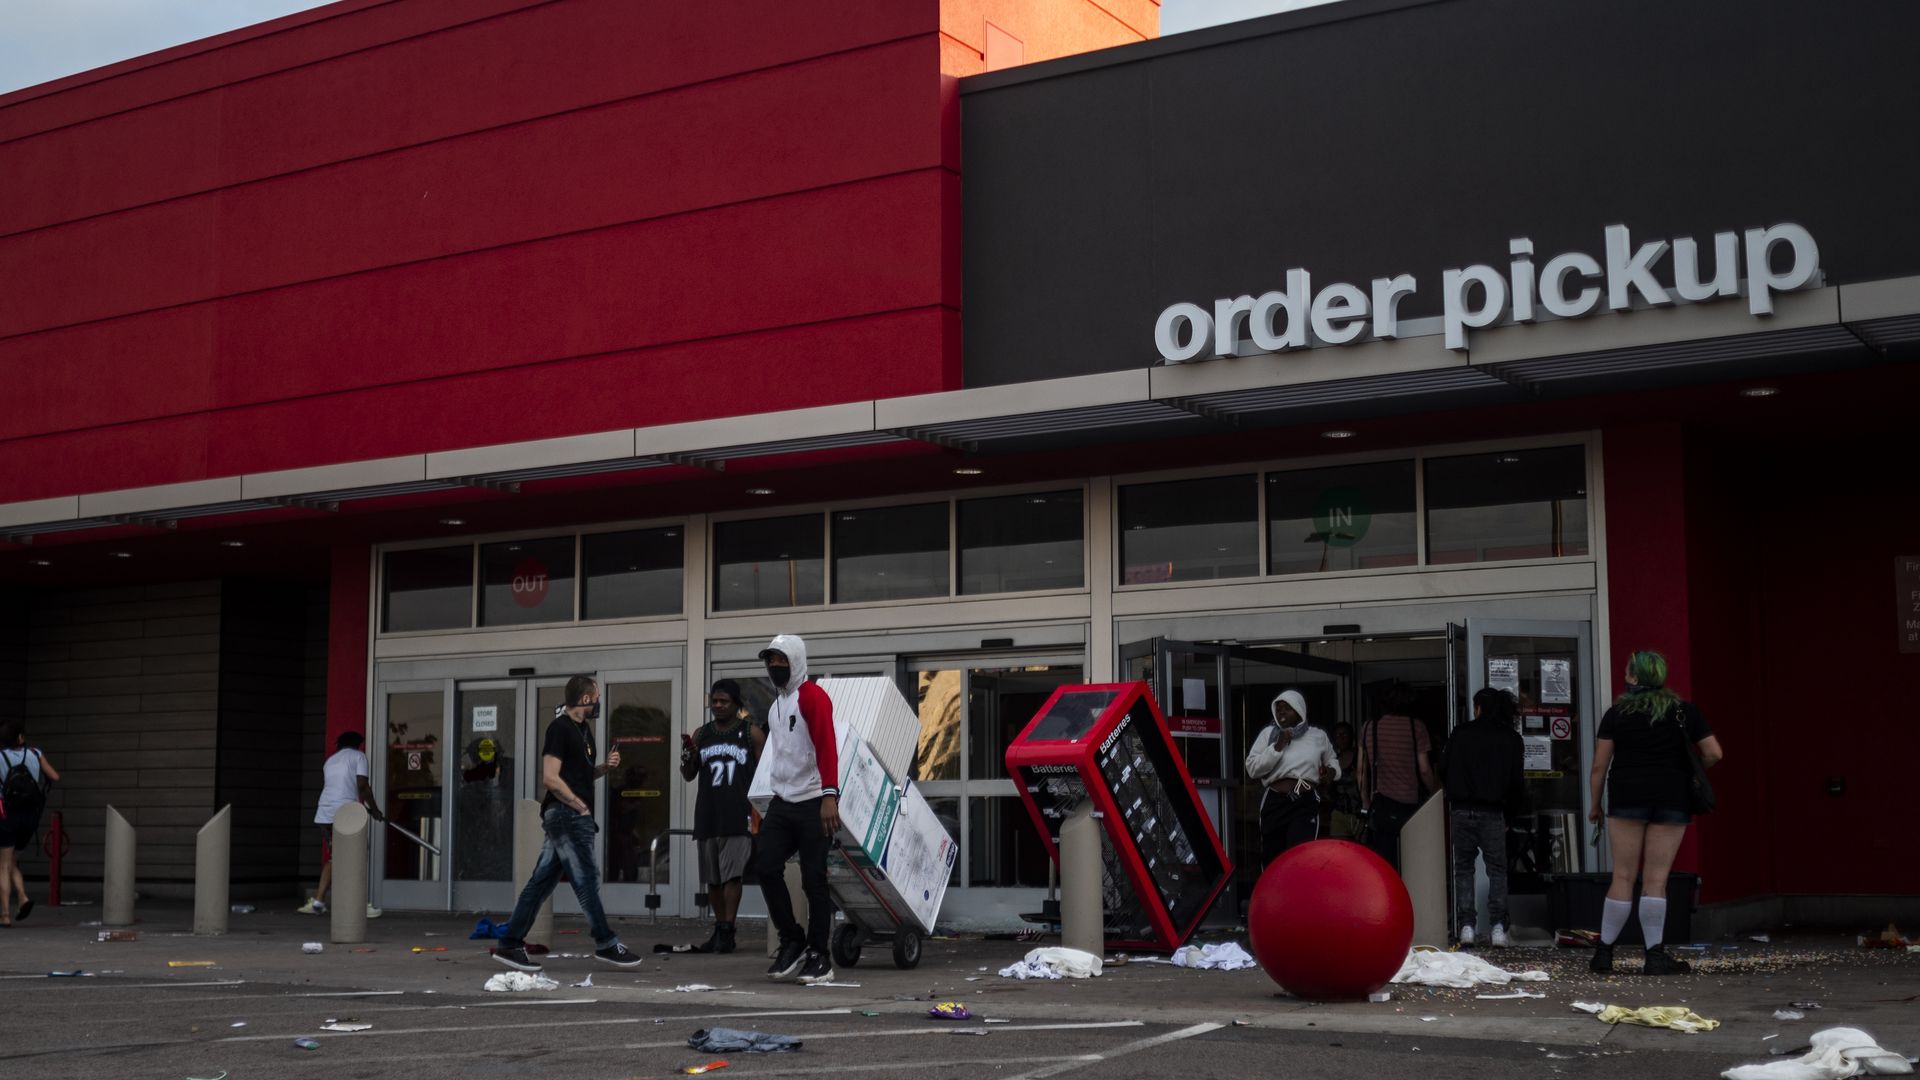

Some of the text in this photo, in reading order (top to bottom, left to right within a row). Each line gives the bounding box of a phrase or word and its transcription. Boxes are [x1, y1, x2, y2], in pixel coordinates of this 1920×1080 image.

[1154, 222, 1821, 362] order pickup
[1329, 506, 1353, 528] IN
[512, 574, 547, 593] OUT
[1099, 713, 1132, 756] Batteries
[710, 760, 737, 787] 21
